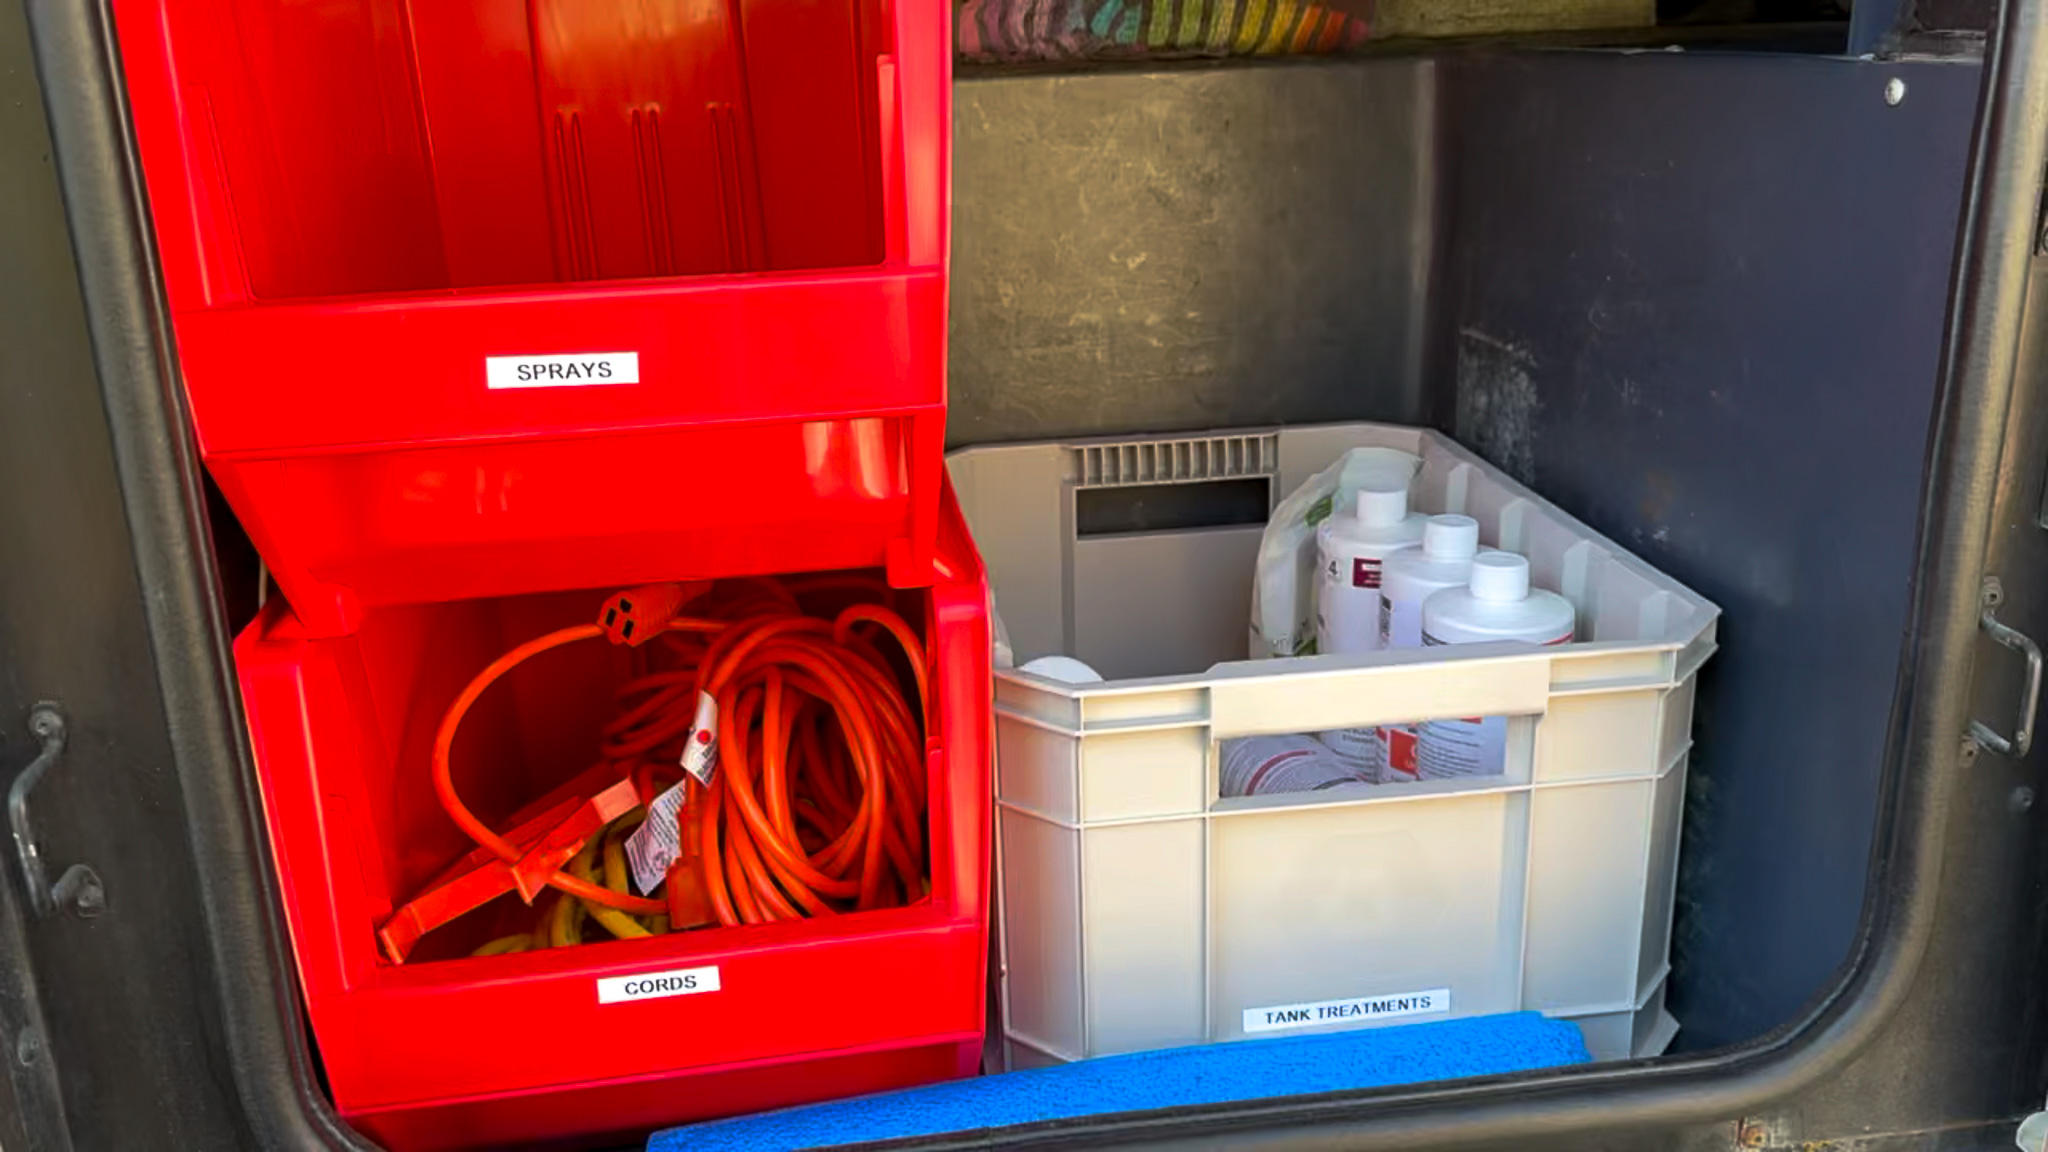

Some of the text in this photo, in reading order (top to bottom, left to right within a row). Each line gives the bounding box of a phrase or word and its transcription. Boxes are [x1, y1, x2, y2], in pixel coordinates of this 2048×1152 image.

[517, 361, 612, 381] SPRAYS
[624, 975, 697, 995] CORDS
[1265, 996, 1431, 1025] TANK TREATMENTS
